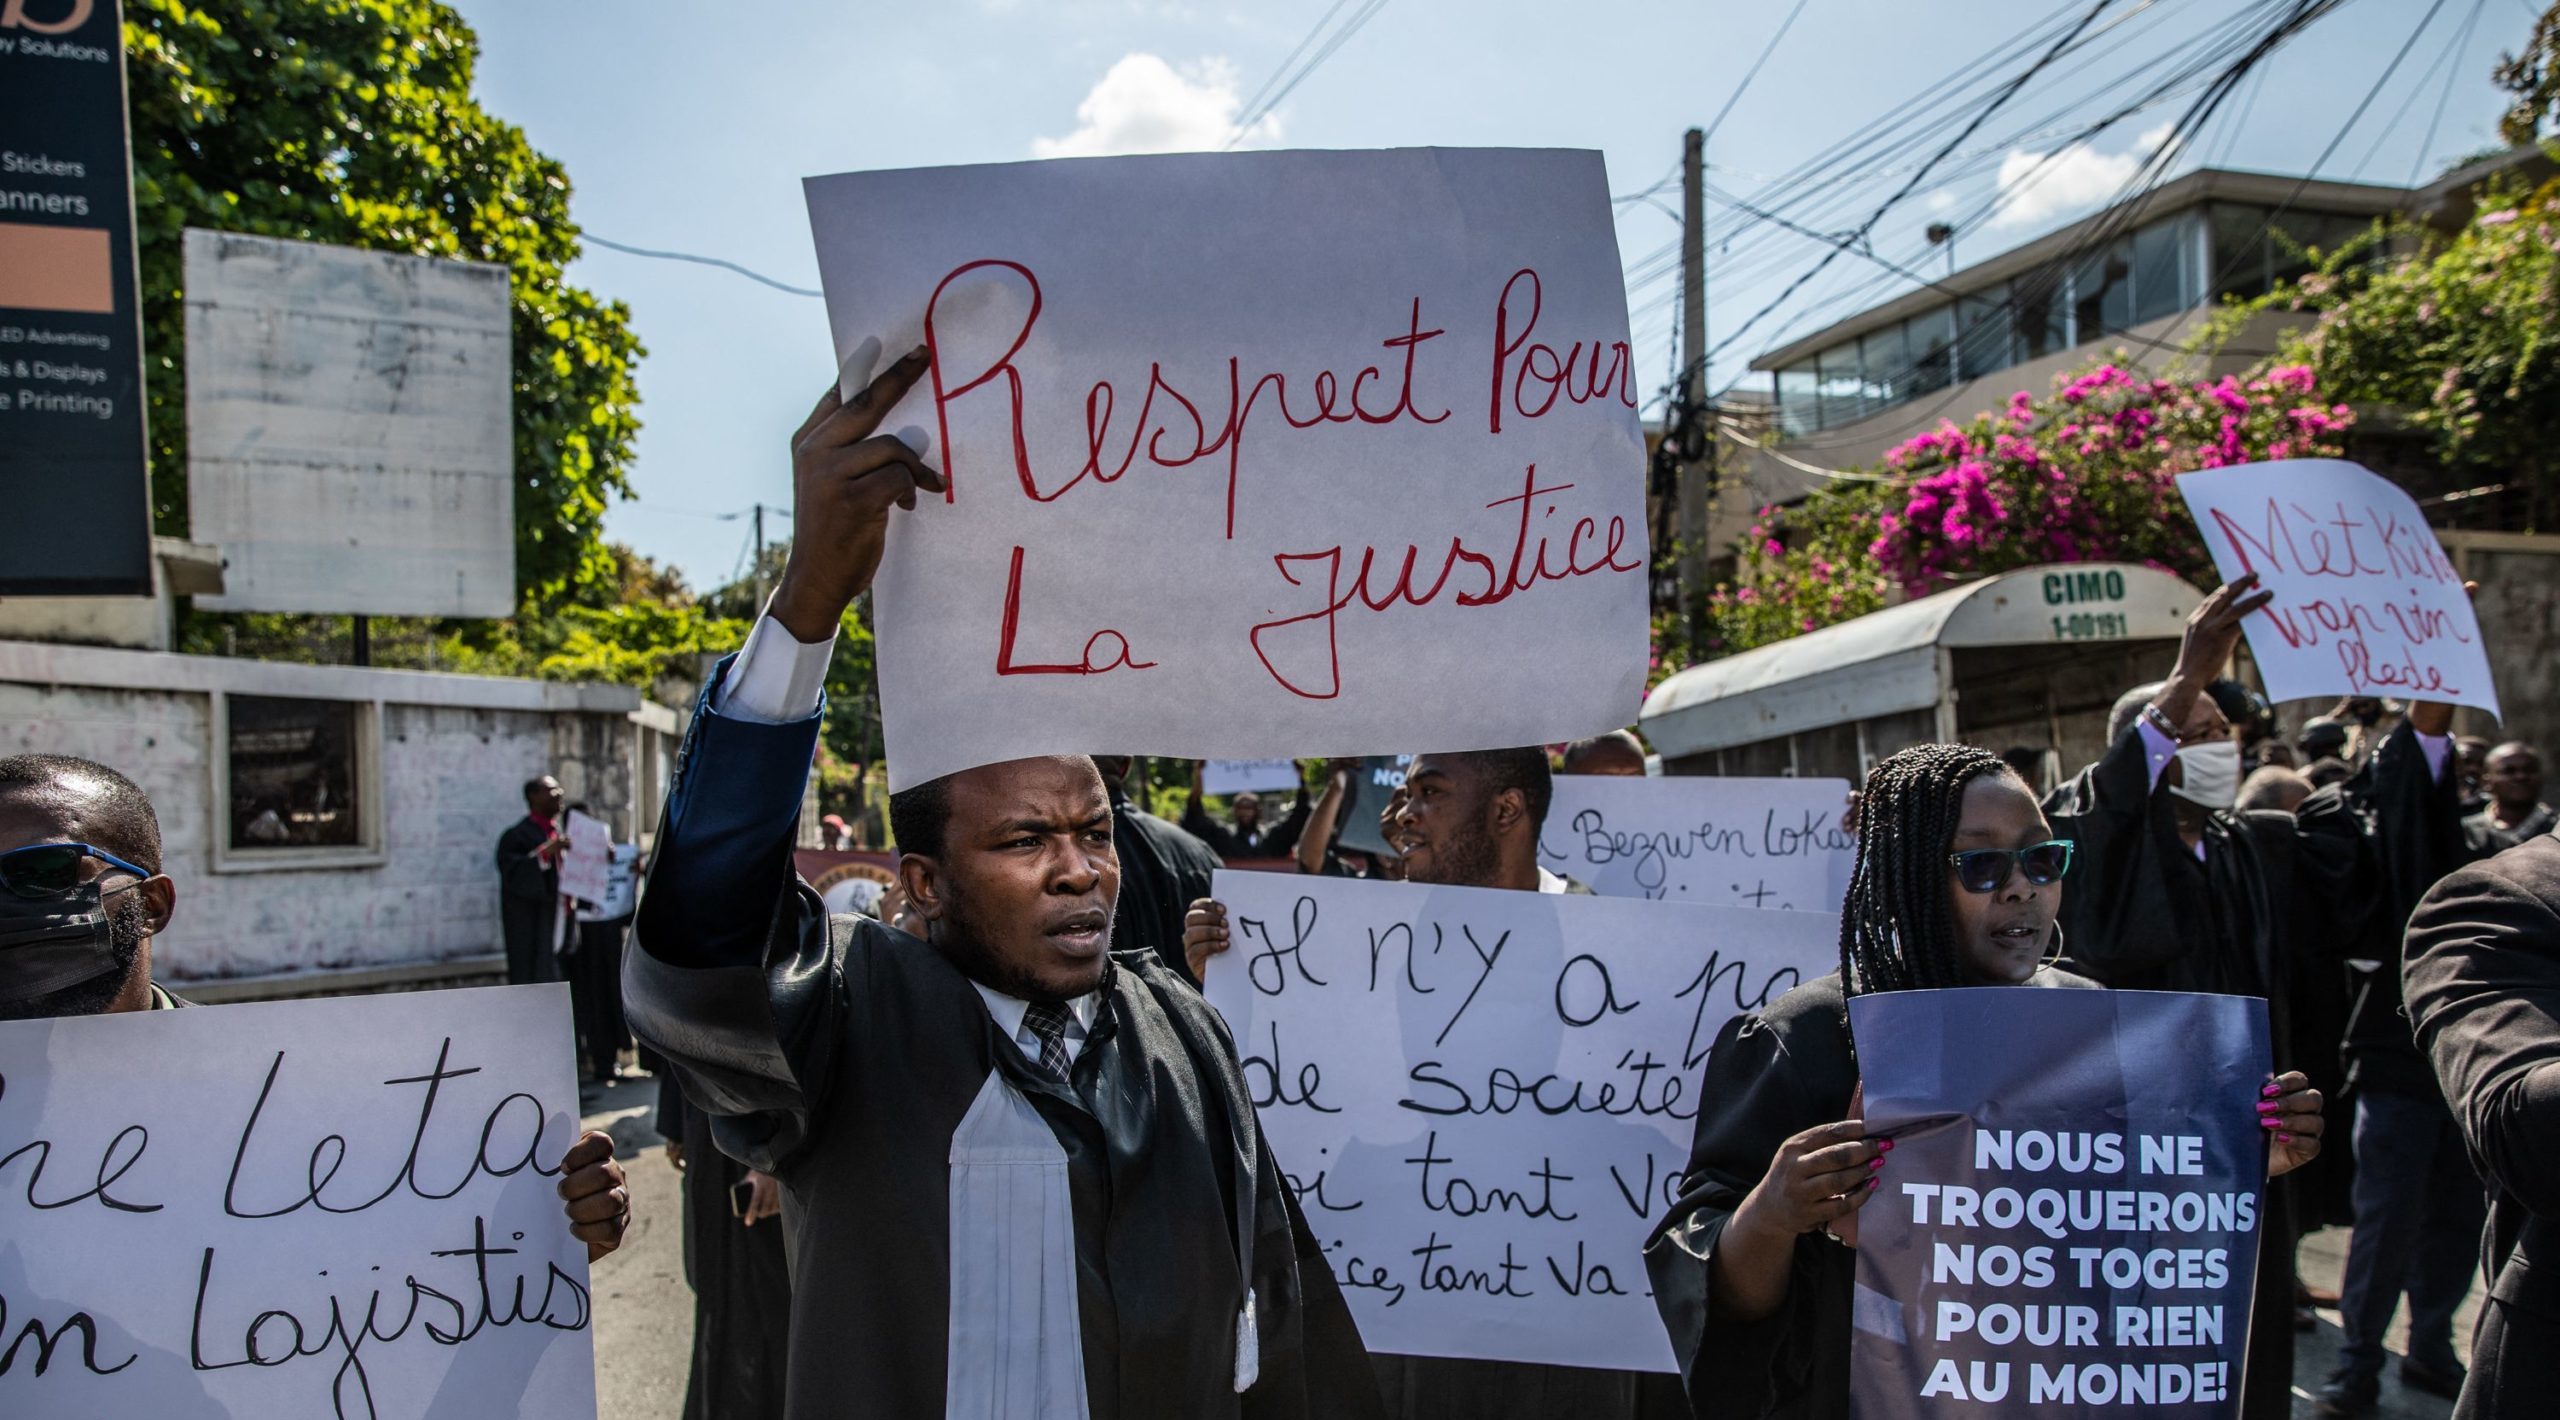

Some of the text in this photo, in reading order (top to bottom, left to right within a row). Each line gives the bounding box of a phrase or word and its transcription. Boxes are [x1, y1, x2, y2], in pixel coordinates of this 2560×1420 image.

[20, 36, 109, 63] Solutions
[2, 150, 85, 178] Stickers
[27, 328, 110, 350] Advertising
[14, 360, 30, 378] &
[33, 360, 107, 385] Displays
[19, 389, 113, 419] Printing
[924, 259, 1636, 540] Respect Pour
[998, 463, 1641, 700] La Justice
[2043, 570, 2125, 606] CIMO
[1555, 953, 1640, 1027] a
[1241, 1020, 1699, 1120] de société
[1405, 1130, 1579, 1221] tant
[1974, 1128, 2204, 1176] NOUS NE
[1901, 1181, 2256, 1240] TROQUERONS
[1412, 1232, 1534, 1298] tant
[1932, 1242, 2230, 1290] NOS TOGES
[1935, 1300, 2224, 1347] POUR RIEN
[1920, 1358, 2229, 1405] AU MONDE!
